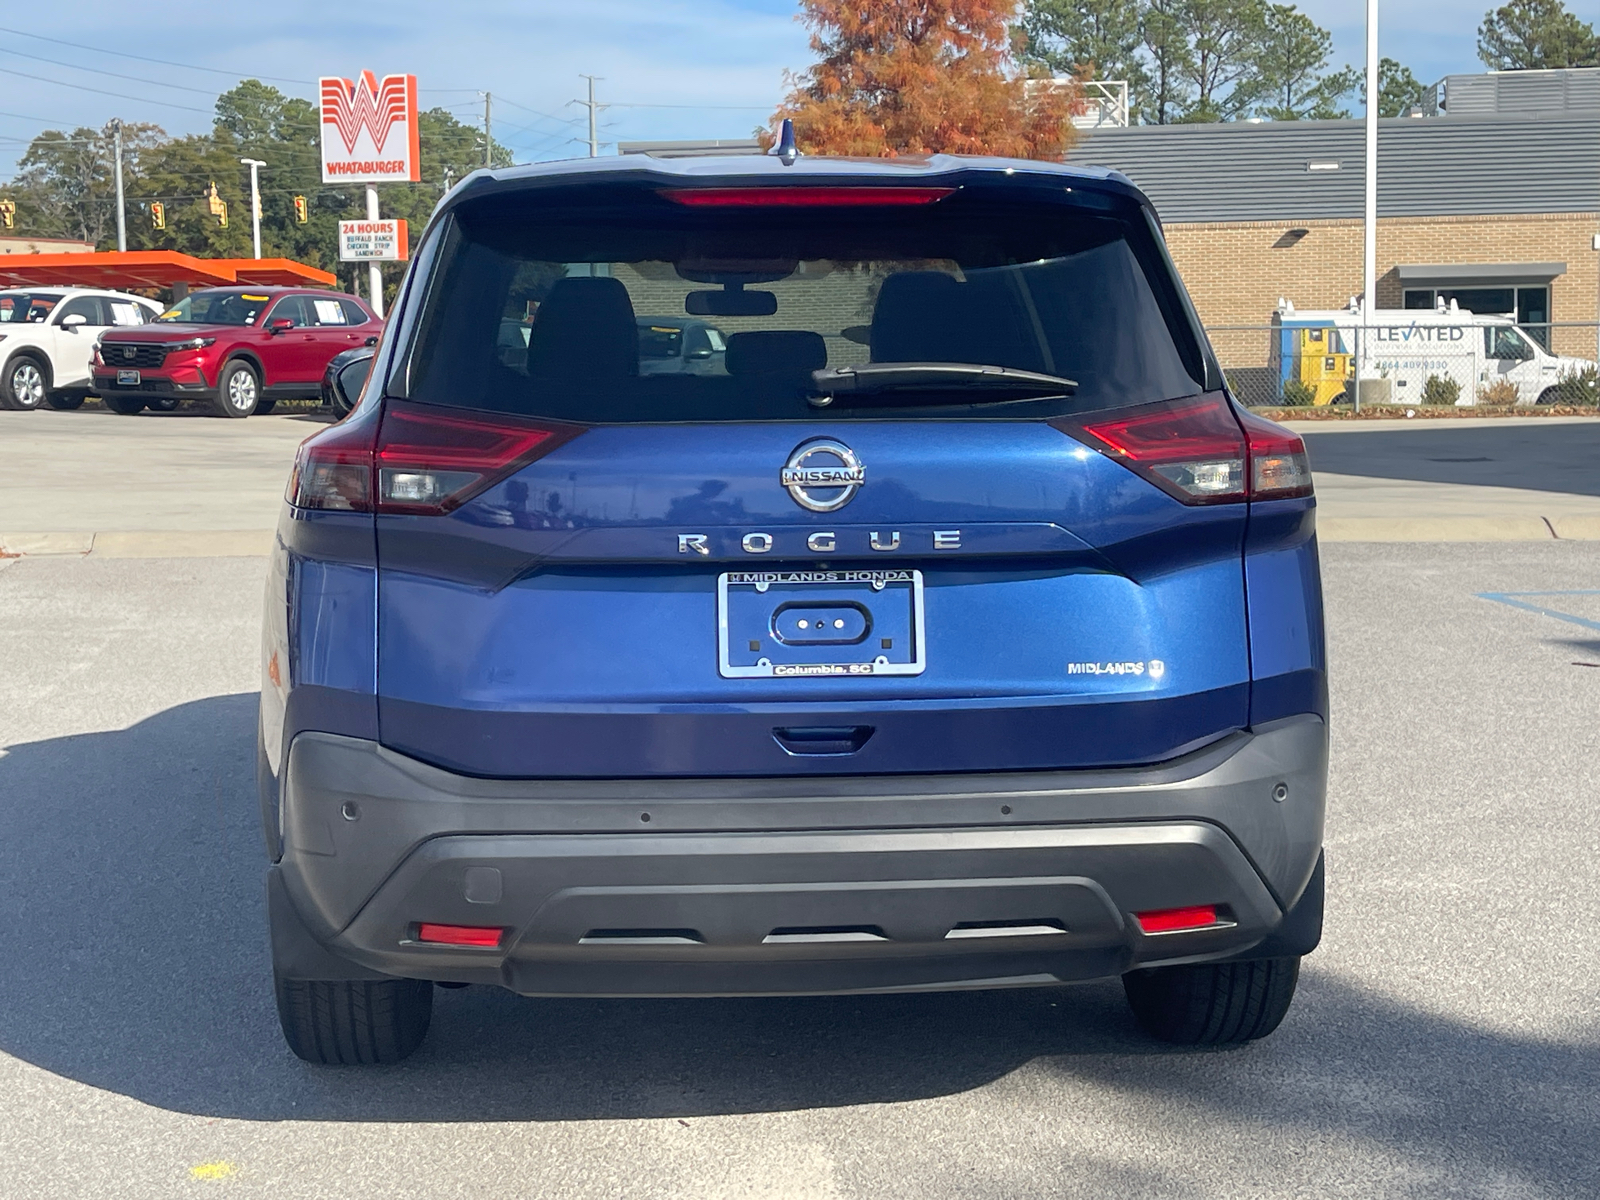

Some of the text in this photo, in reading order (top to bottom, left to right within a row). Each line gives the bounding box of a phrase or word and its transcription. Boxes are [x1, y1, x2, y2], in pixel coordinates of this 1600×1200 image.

[326, 160, 405, 175] WHATABURGER
[343, 223, 393, 234] 24 HOURS
[792, 471, 856, 482] NISSAN
[677, 530, 962, 554] ROGUE
[743, 571, 909, 582] MIDLANDS HONDA
[775, 663, 871, 675] Columbia, SC
[1067, 661, 1145, 675] MIDLANDS
